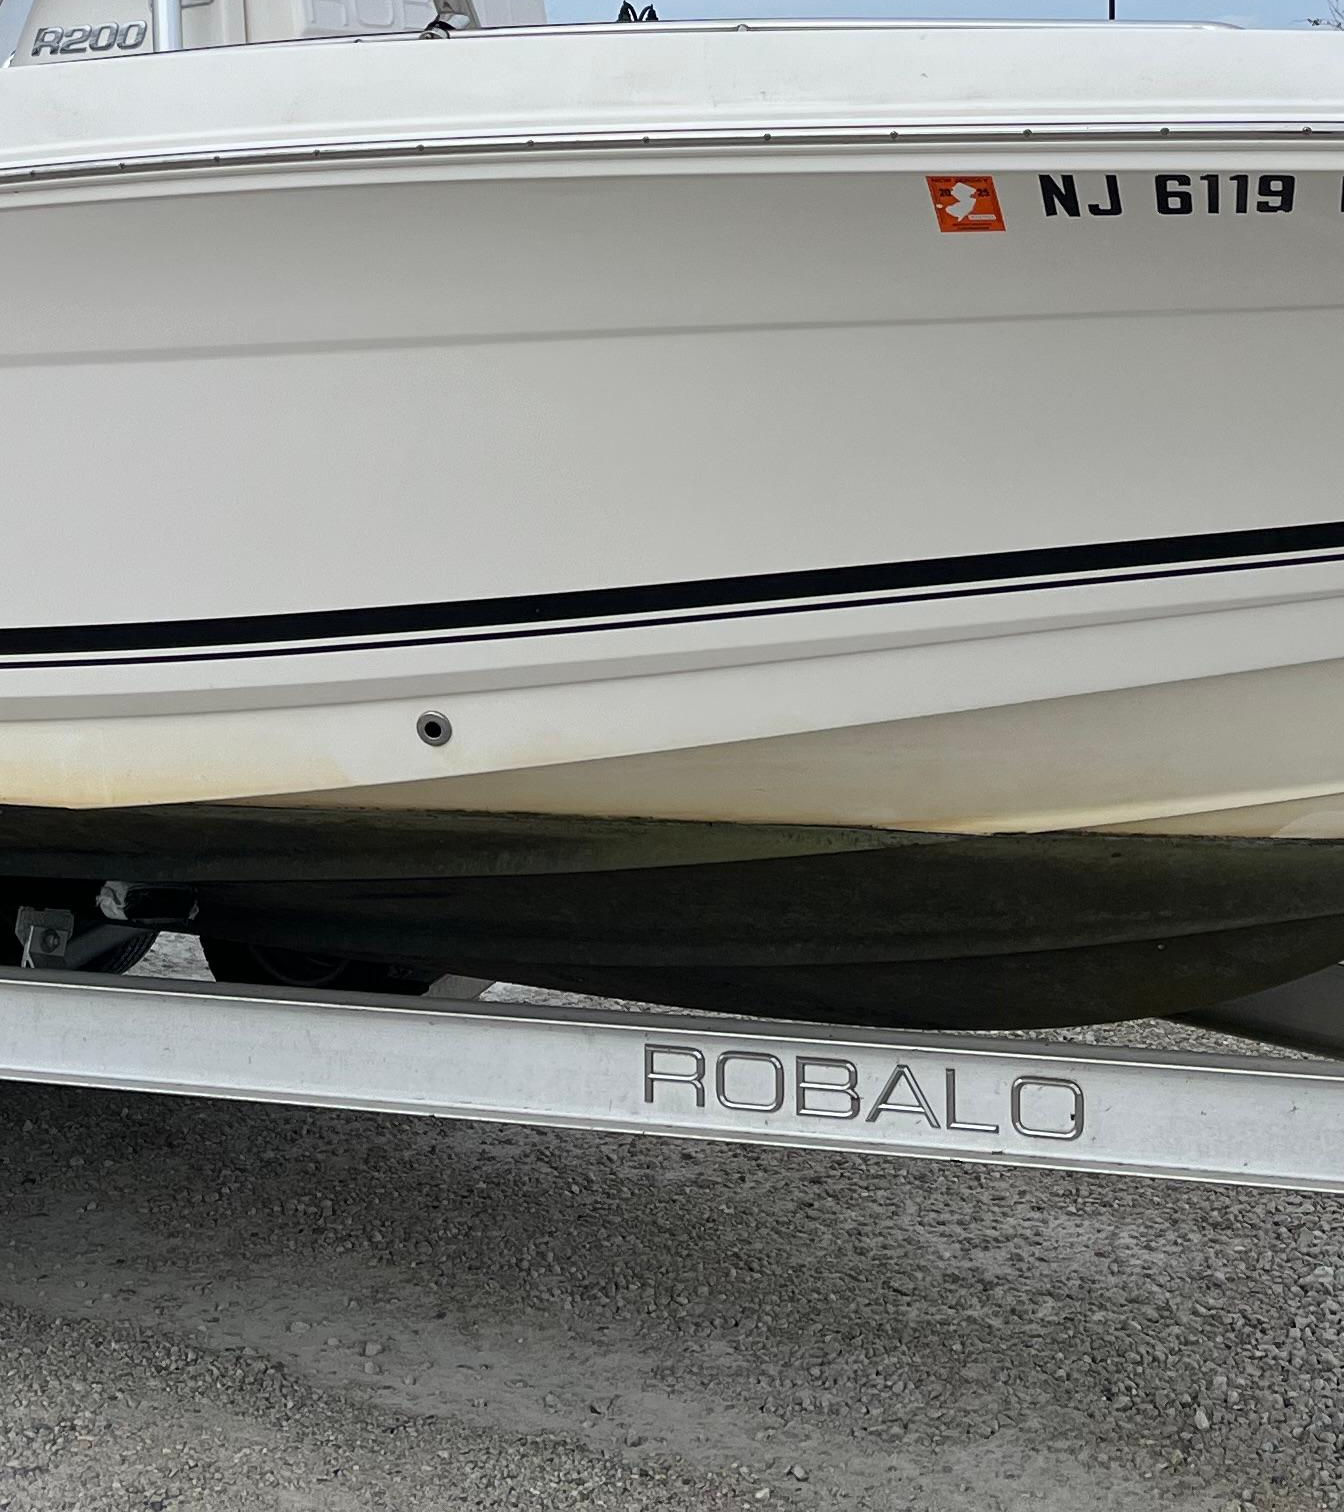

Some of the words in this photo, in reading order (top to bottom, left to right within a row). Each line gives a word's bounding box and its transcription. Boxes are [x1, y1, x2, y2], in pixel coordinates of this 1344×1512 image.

[31, 20, 147, 56] R200
[1038, 174, 1122, 217] NJ
[1155, 174, 1295, 215] 6119
[644, 1043, 1084, 1140] ROBALO
